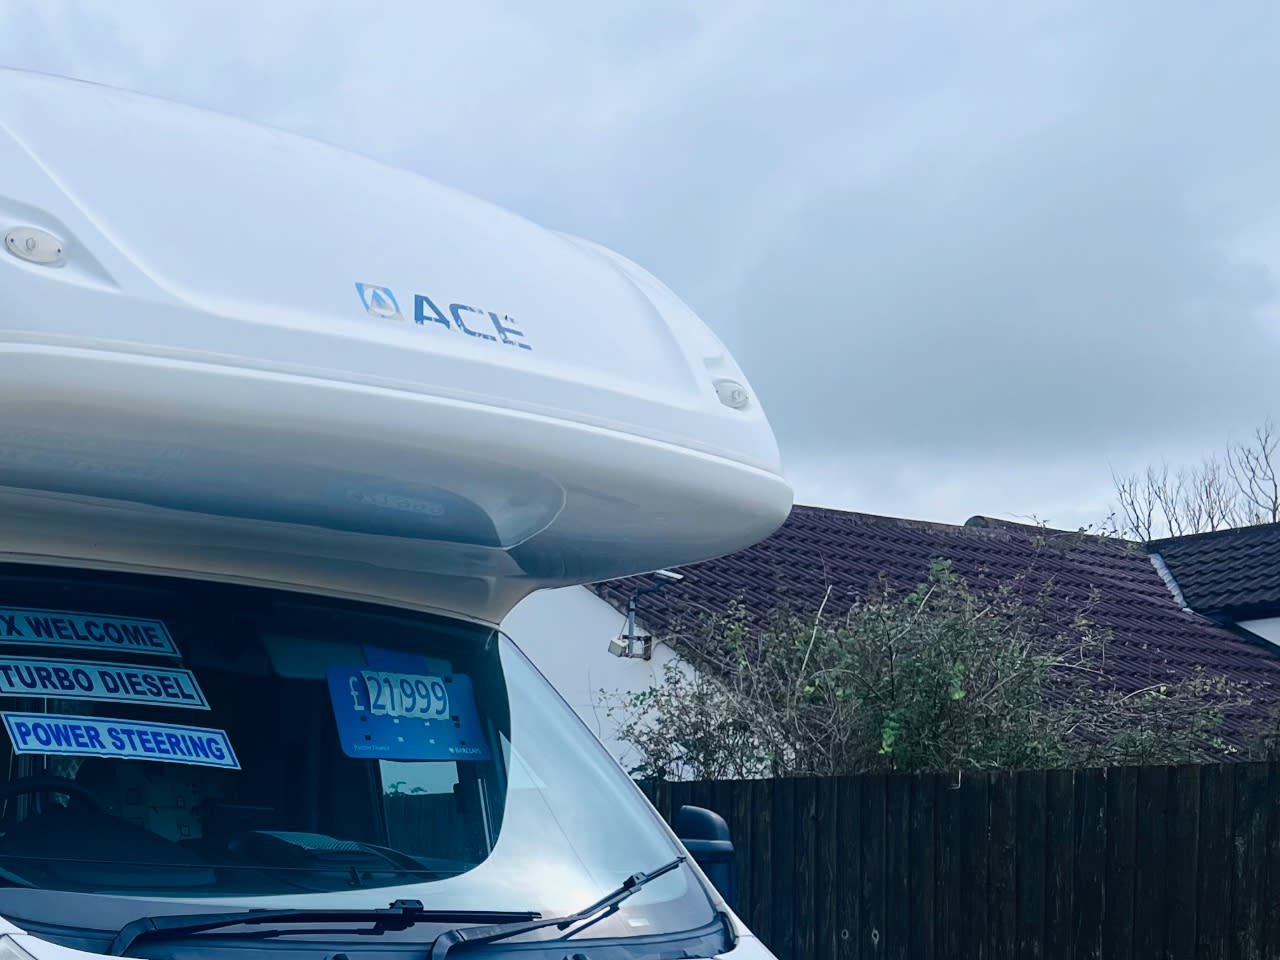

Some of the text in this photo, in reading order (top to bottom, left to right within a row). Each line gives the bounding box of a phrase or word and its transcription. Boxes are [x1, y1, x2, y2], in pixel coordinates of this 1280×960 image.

[414, 294, 532, 351] ACE
[23, 615, 166, 648] WELCOME
[97, 670, 195, 700] DIESEL
[14, 722, 225, 760] POWER STEERING
